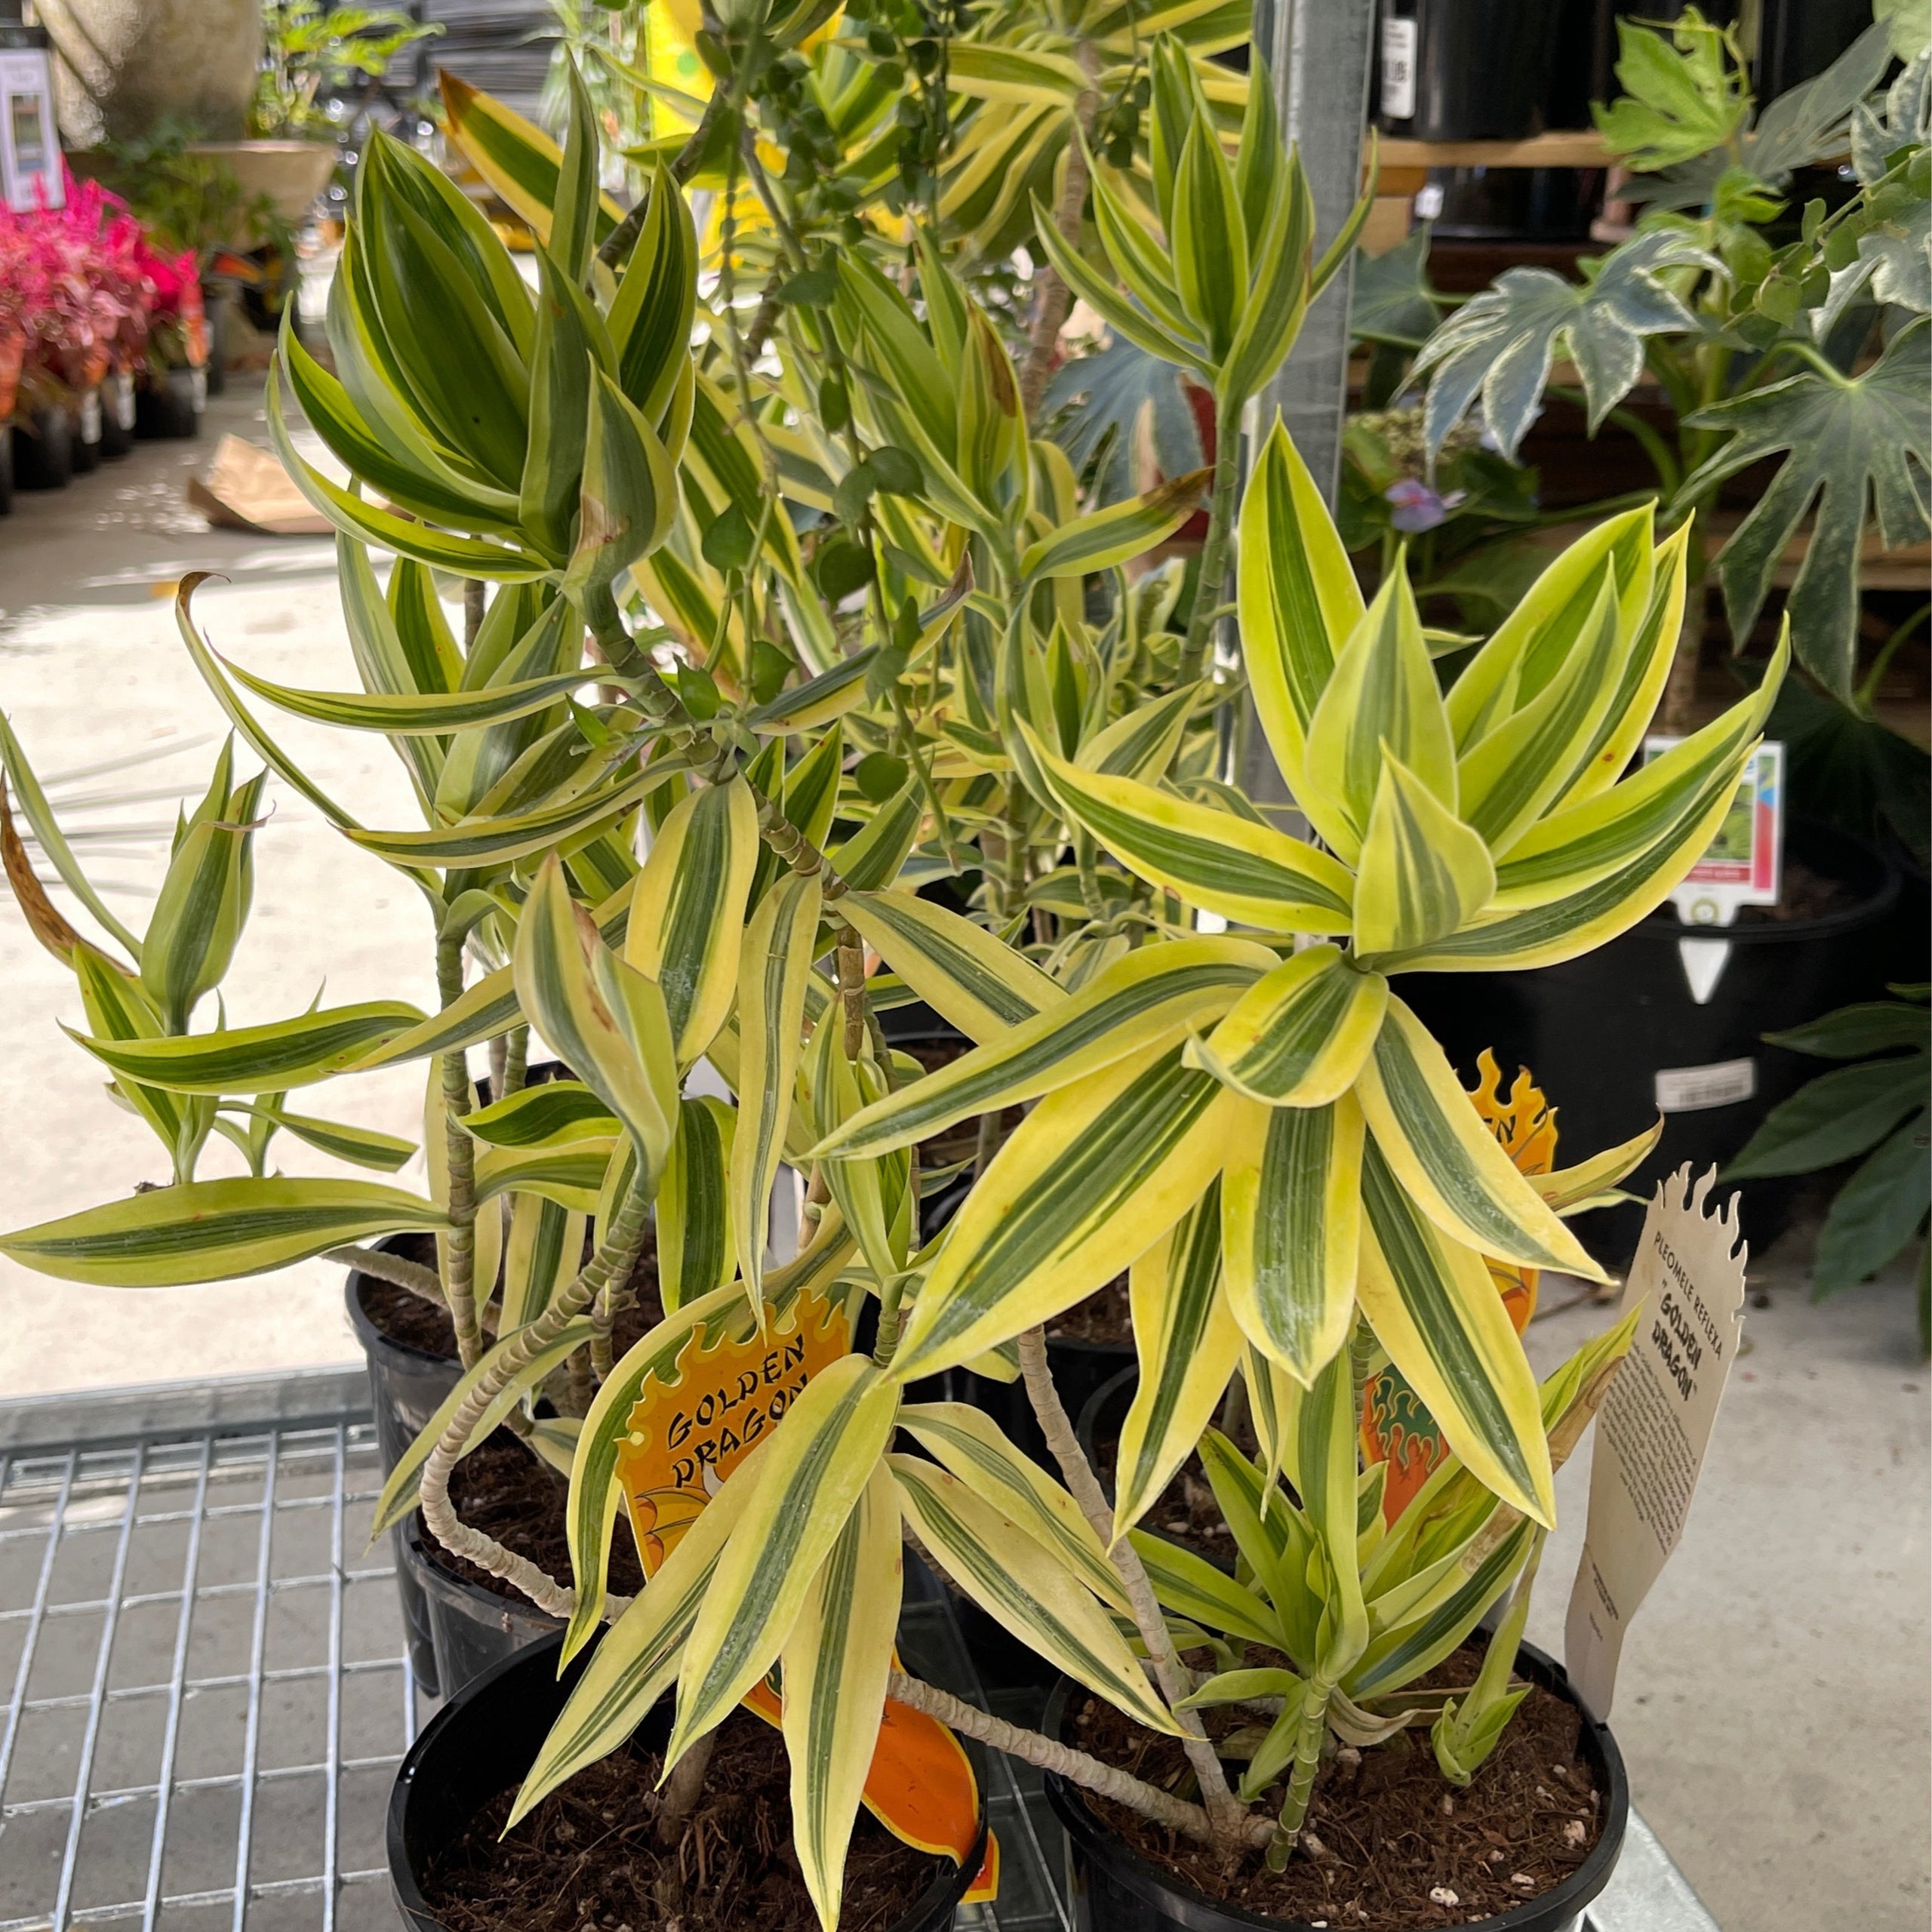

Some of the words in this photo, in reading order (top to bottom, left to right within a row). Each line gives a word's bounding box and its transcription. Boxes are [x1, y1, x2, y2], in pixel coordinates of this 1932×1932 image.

[1654, 1230, 1694, 1303] PLEOMELE
[1693, 1294, 1723, 1361] REFLEXA
[667, 1334, 805, 1451] GOLDEN
